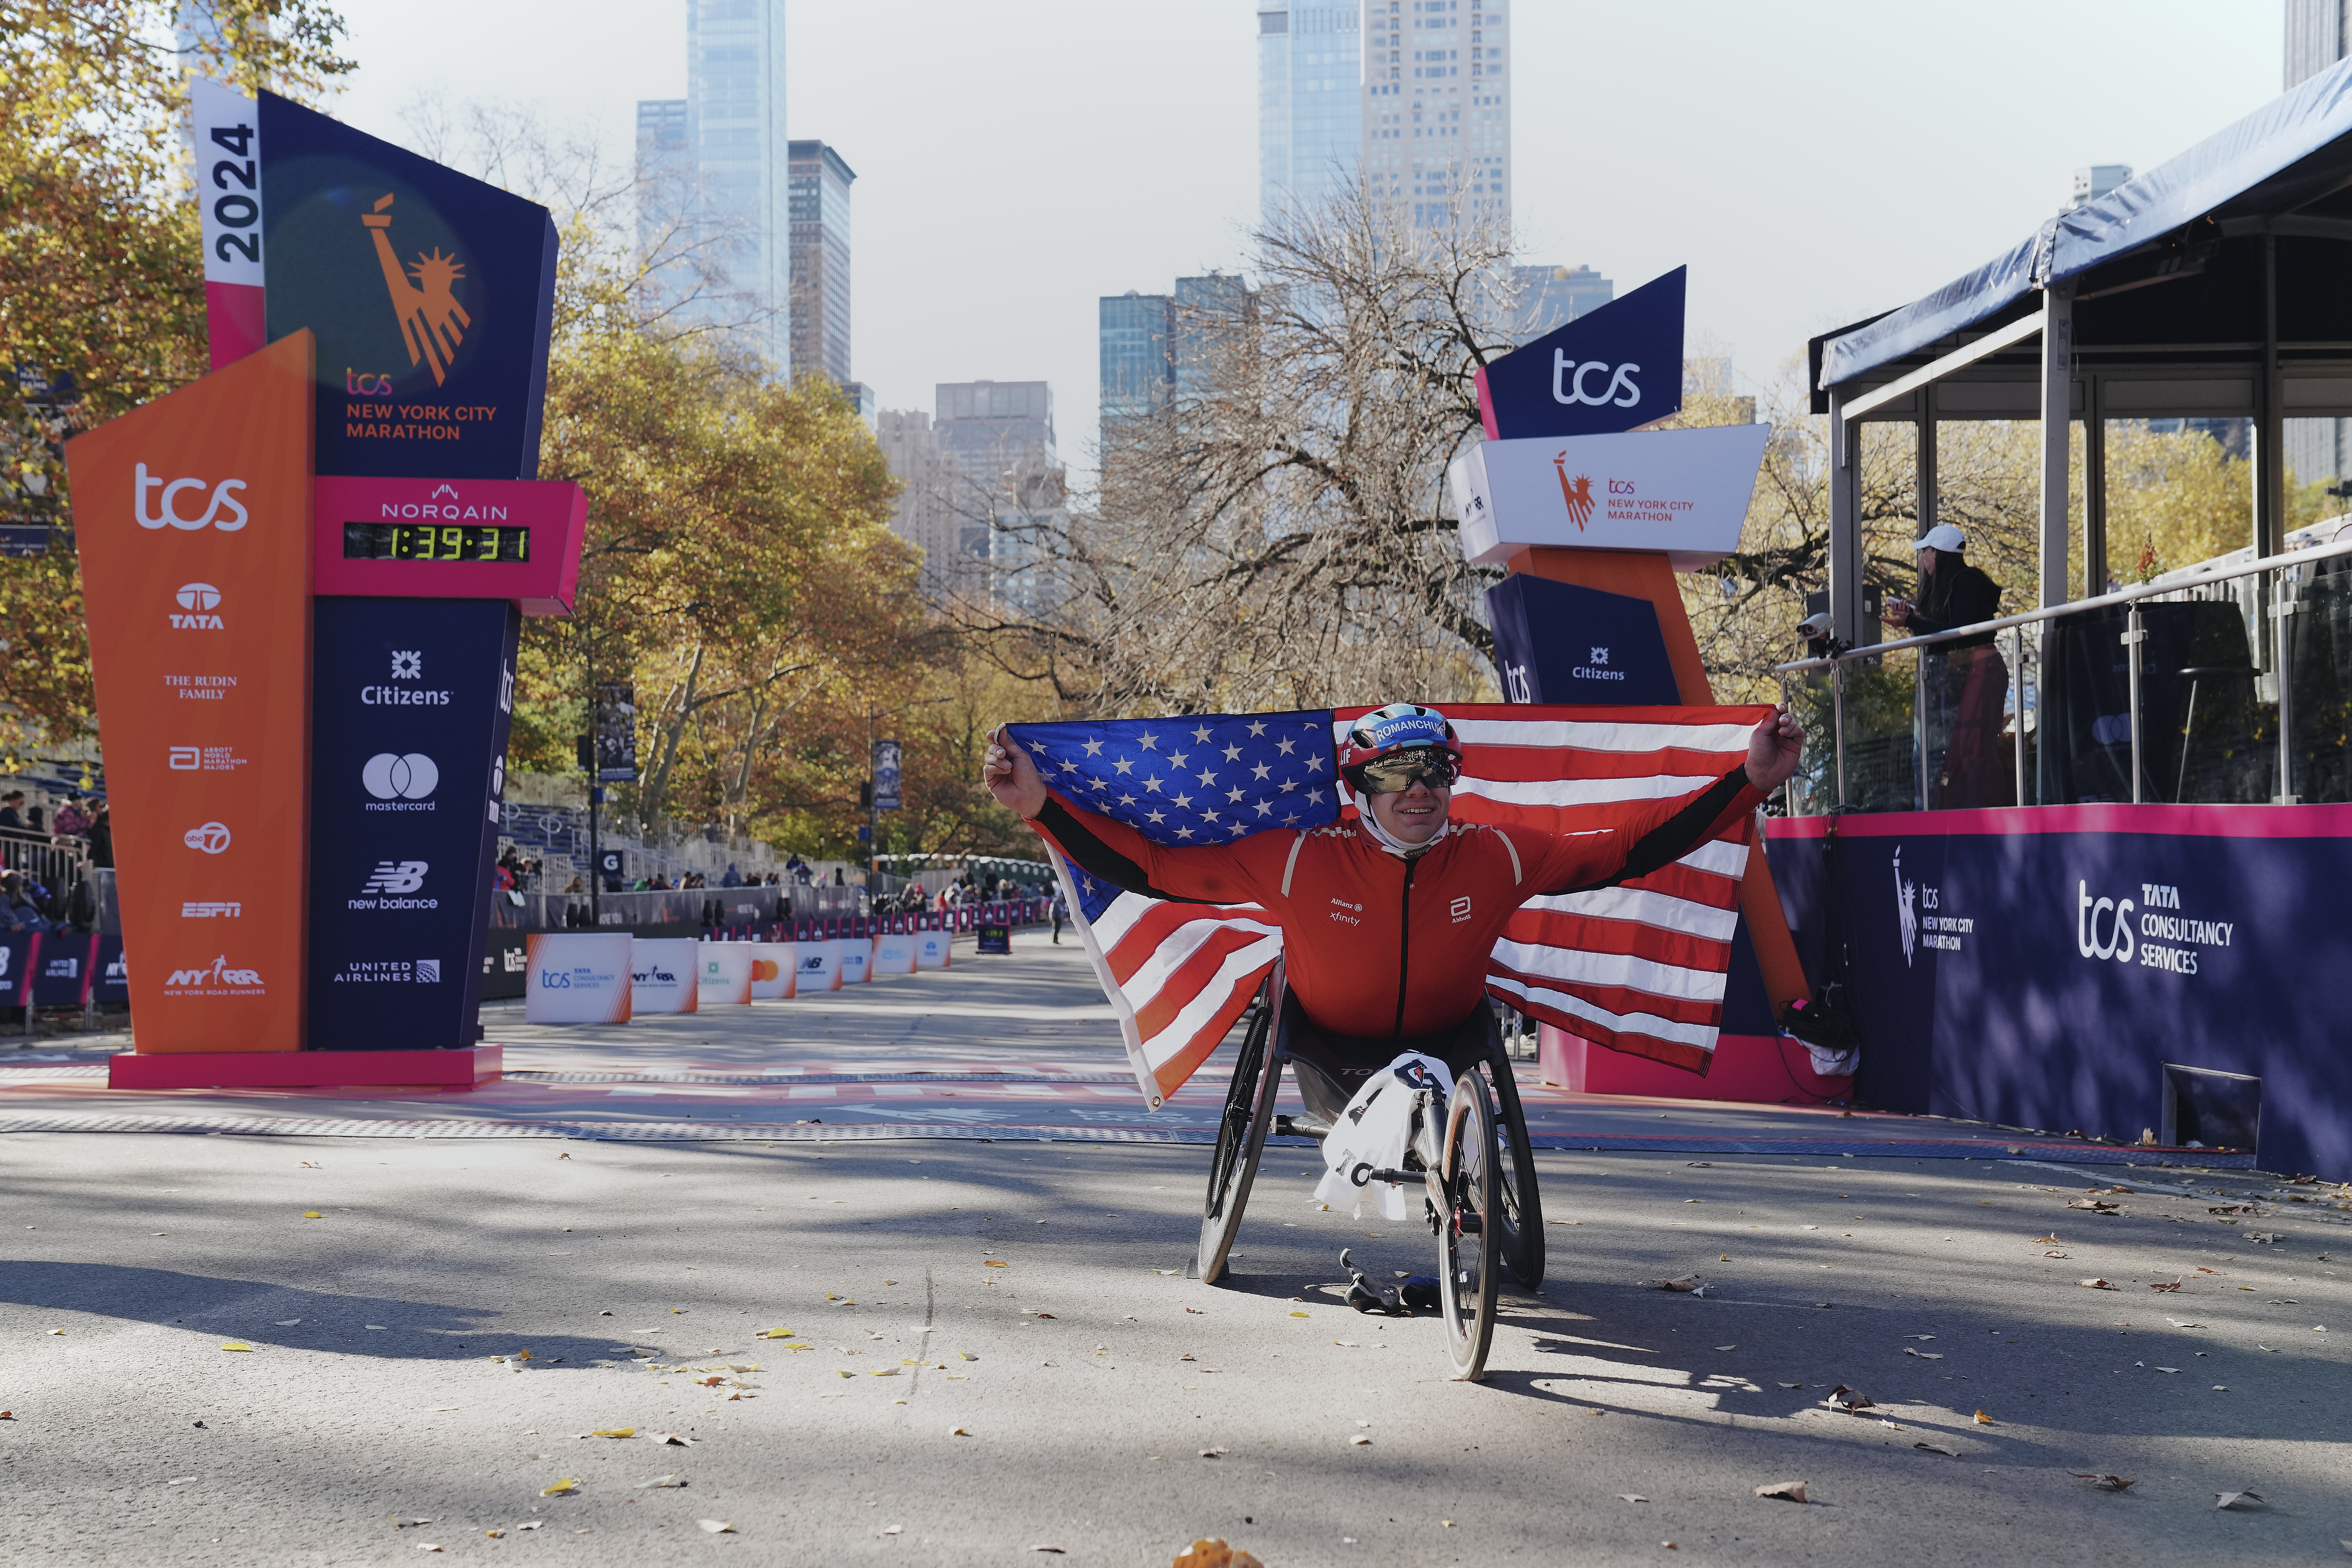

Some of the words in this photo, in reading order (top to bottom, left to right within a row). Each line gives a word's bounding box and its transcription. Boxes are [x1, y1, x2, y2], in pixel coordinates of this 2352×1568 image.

[211, 123, 260, 263] 2024
[347, 367, 392, 395] tcs
[1553, 347, 1641, 408] tcs
[347, 404, 392, 419] NEW
[398, 405, 450, 421] YORK
[455, 406, 497, 422] CITY
[347, 423, 460, 440] MARATHON
[1609, 478, 1635, 494] tcs
[135, 462, 248, 532] tcs
[1608, 499, 1635, 508] NEW
[1637, 500, 1667, 509] YORK
[1670, 501, 1694, 511] CITY
[381, 503, 507, 520] NORQAIN
[1608, 510, 1672, 522] MARATHON
[169, 614, 224, 629] TATA
[164, 675, 191, 686] THE
[195, 676, 237, 686] RUDIN
[1505, 660, 1531, 703] tcs
[1573, 667, 1625, 681] Citizens
[179, 689, 225, 699] FAMILY
[361, 685, 450, 705] Citizens
[500, 658, 514, 715] tcs
[1375, 720, 1445, 742] ROMANCHUK
[366, 801, 435, 811] mastercard
[348, 899, 377, 909] new
[380, 897, 438, 909] balance
[1331, 898, 1353, 909] Allianz
[1923, 883, 1938, 909] tcs
[2142, 883, 2180, 909] TATA
[182, 902, 241, 917] ESPN
[1330, 912, 1360, 926] xfinity
[1452, 914, 1471, 923] Abbott
[1923, 915, 1938, 931] NEW
[1939, 917, 1957, 932] YORK
[1958, 918, 1973, 933] CITY
[2078, 879, 2134, 963] tcs
[2141, 913, 2233, 947] CONSULTANCY
[1923, 933, 1961, 951] MARATHON
[350, 962, 411, 971] UNITED
[2140, 943, 2198, 975] SERVICES
[334, 972, 411, 982] AIRLINES
[542, 969, 570, 988] tcs
